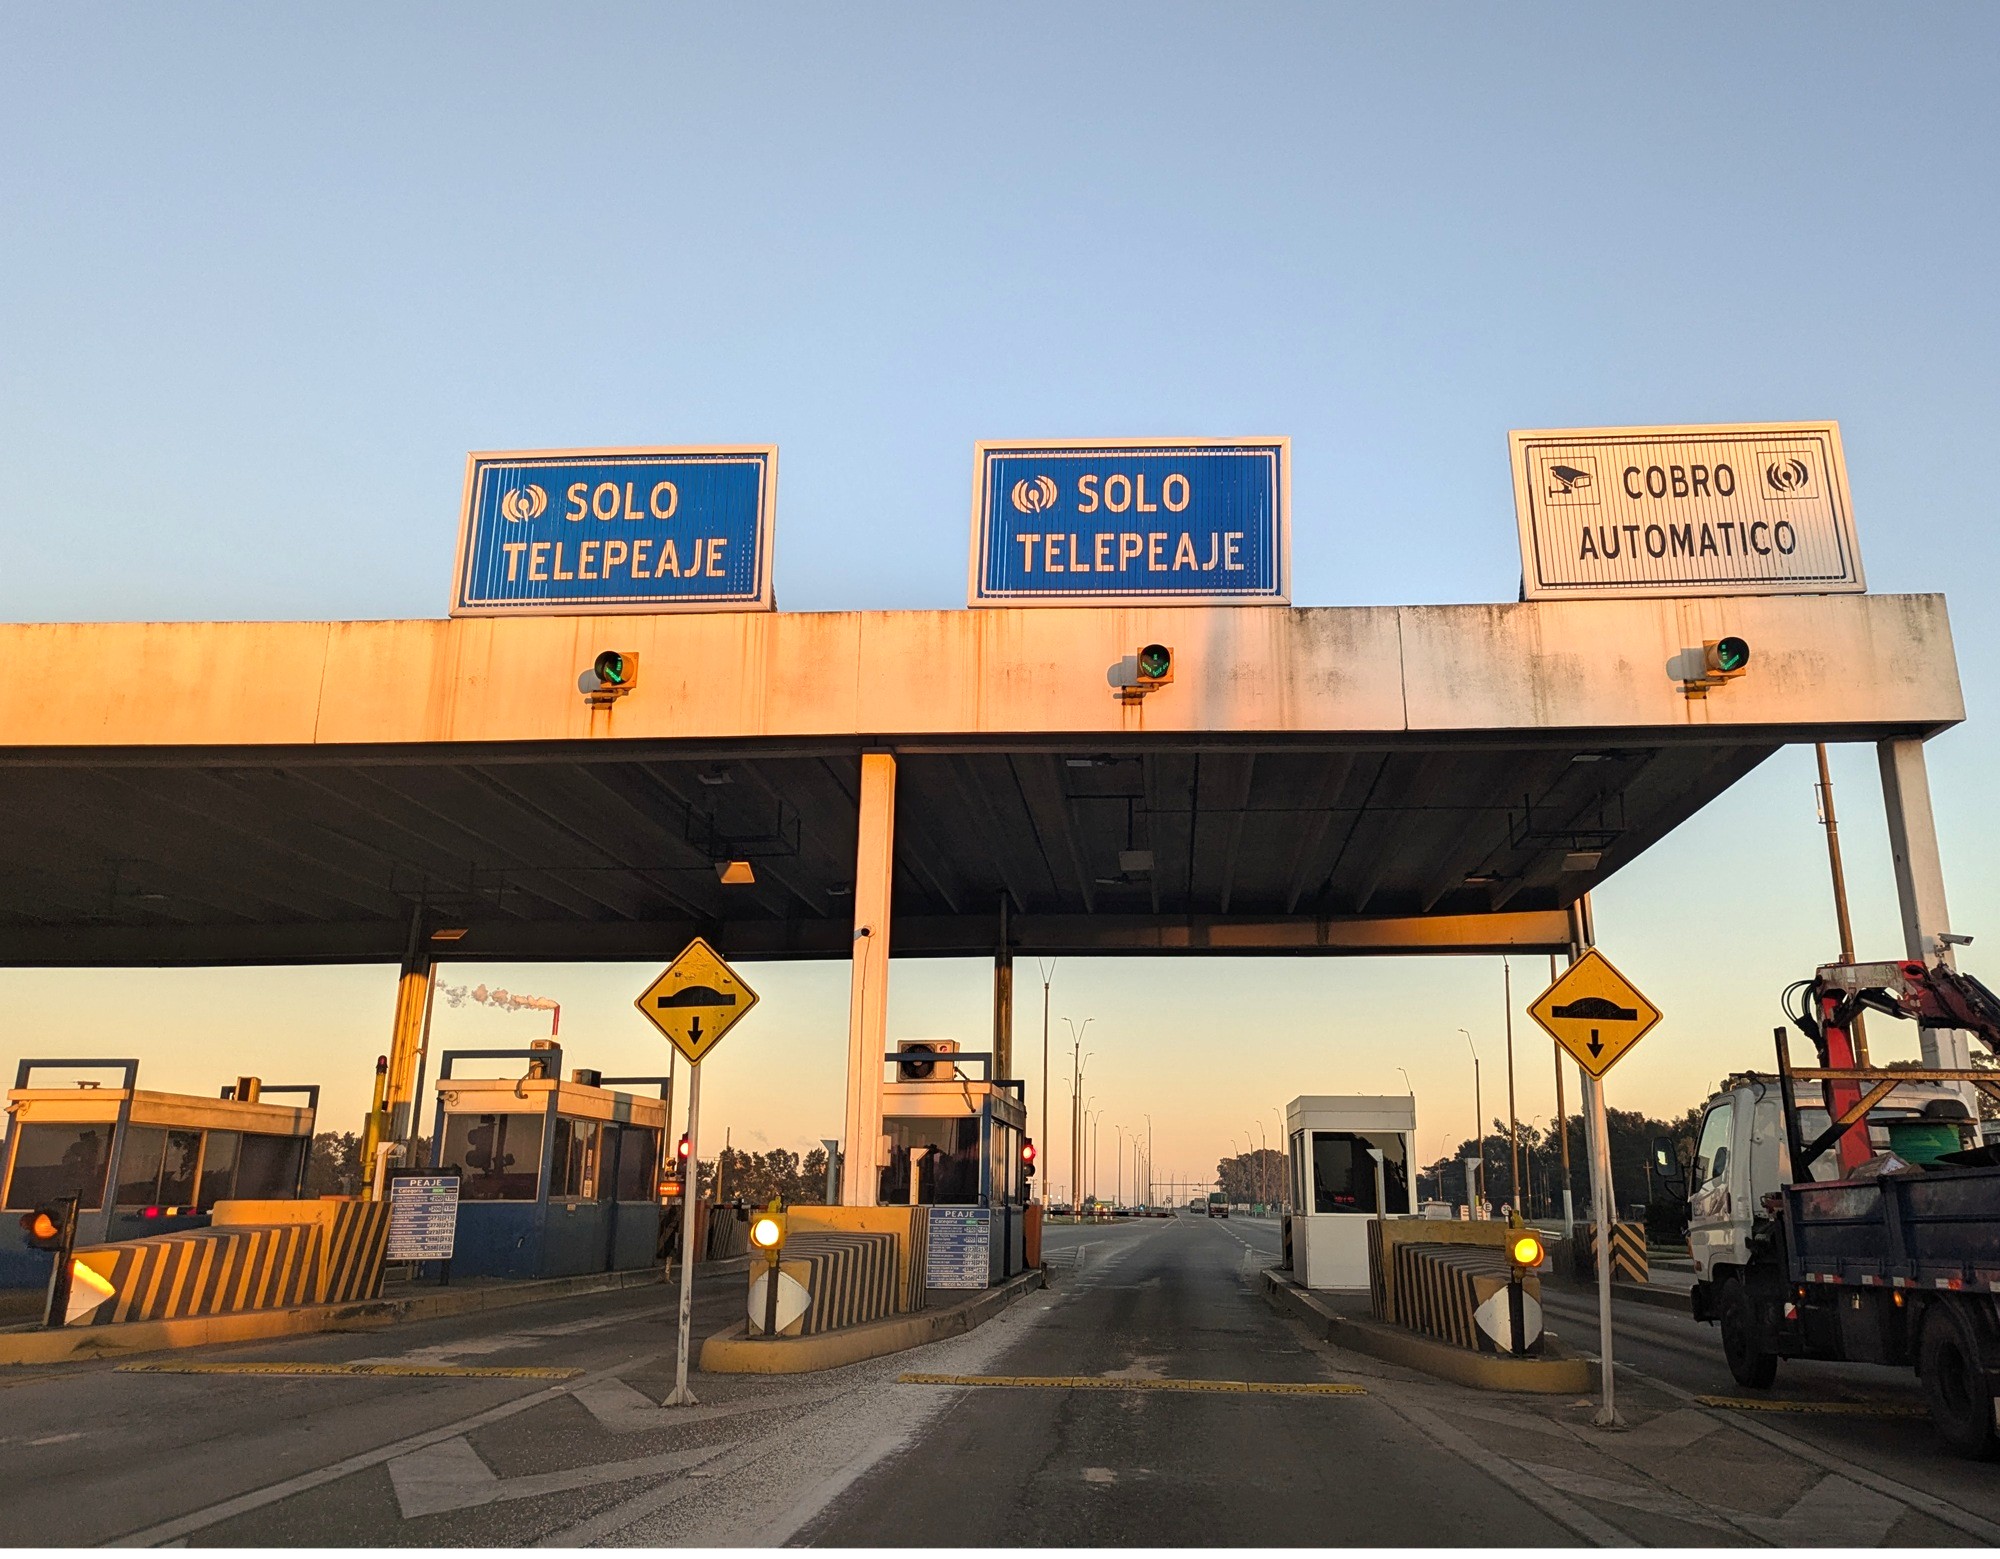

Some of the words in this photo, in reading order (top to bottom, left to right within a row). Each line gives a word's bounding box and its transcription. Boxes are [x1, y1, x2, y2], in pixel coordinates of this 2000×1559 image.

[565, 481, 678, 522] SOLO
[1077, 473, 1190, 513] SOLO
[1622, 463, 1736, 500] COBRO
[502, 538, 728, 581] TELEPEAJE
[1016, 532, 1245, 572] TELEPEAJE
[1579, 520, 1797, 560] AUTOMATICO
